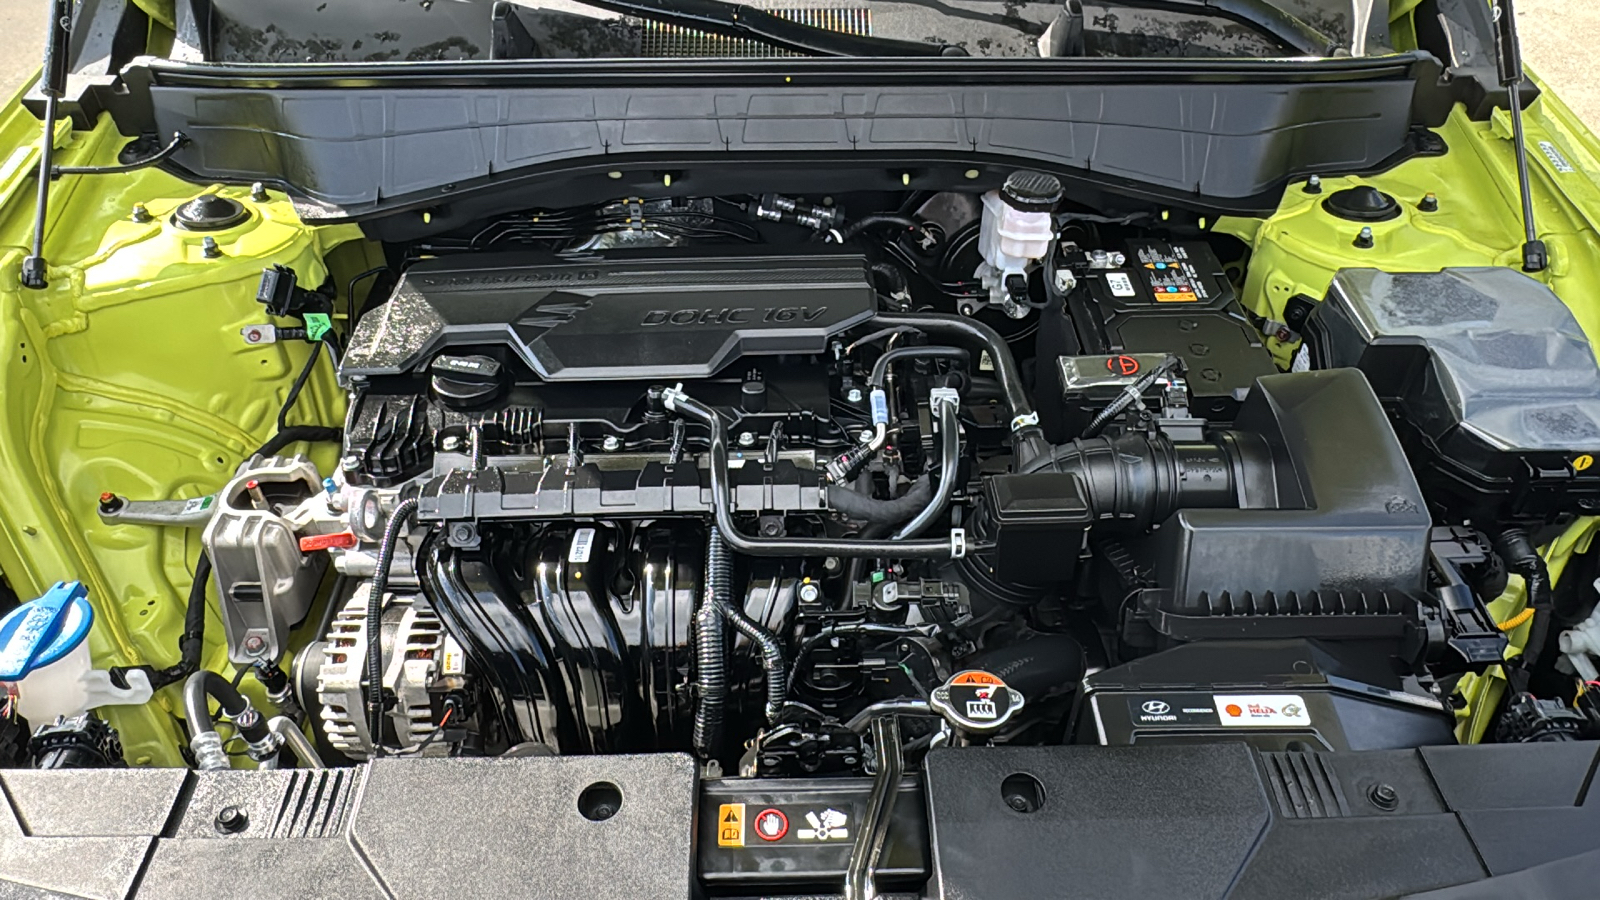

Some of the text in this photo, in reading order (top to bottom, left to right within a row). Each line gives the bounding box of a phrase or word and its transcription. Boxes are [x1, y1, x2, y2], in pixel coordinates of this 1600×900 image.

[640, 305, 827, 326] DOHC 16V
[1140, 714, 1178, 722] HYUNDAI
